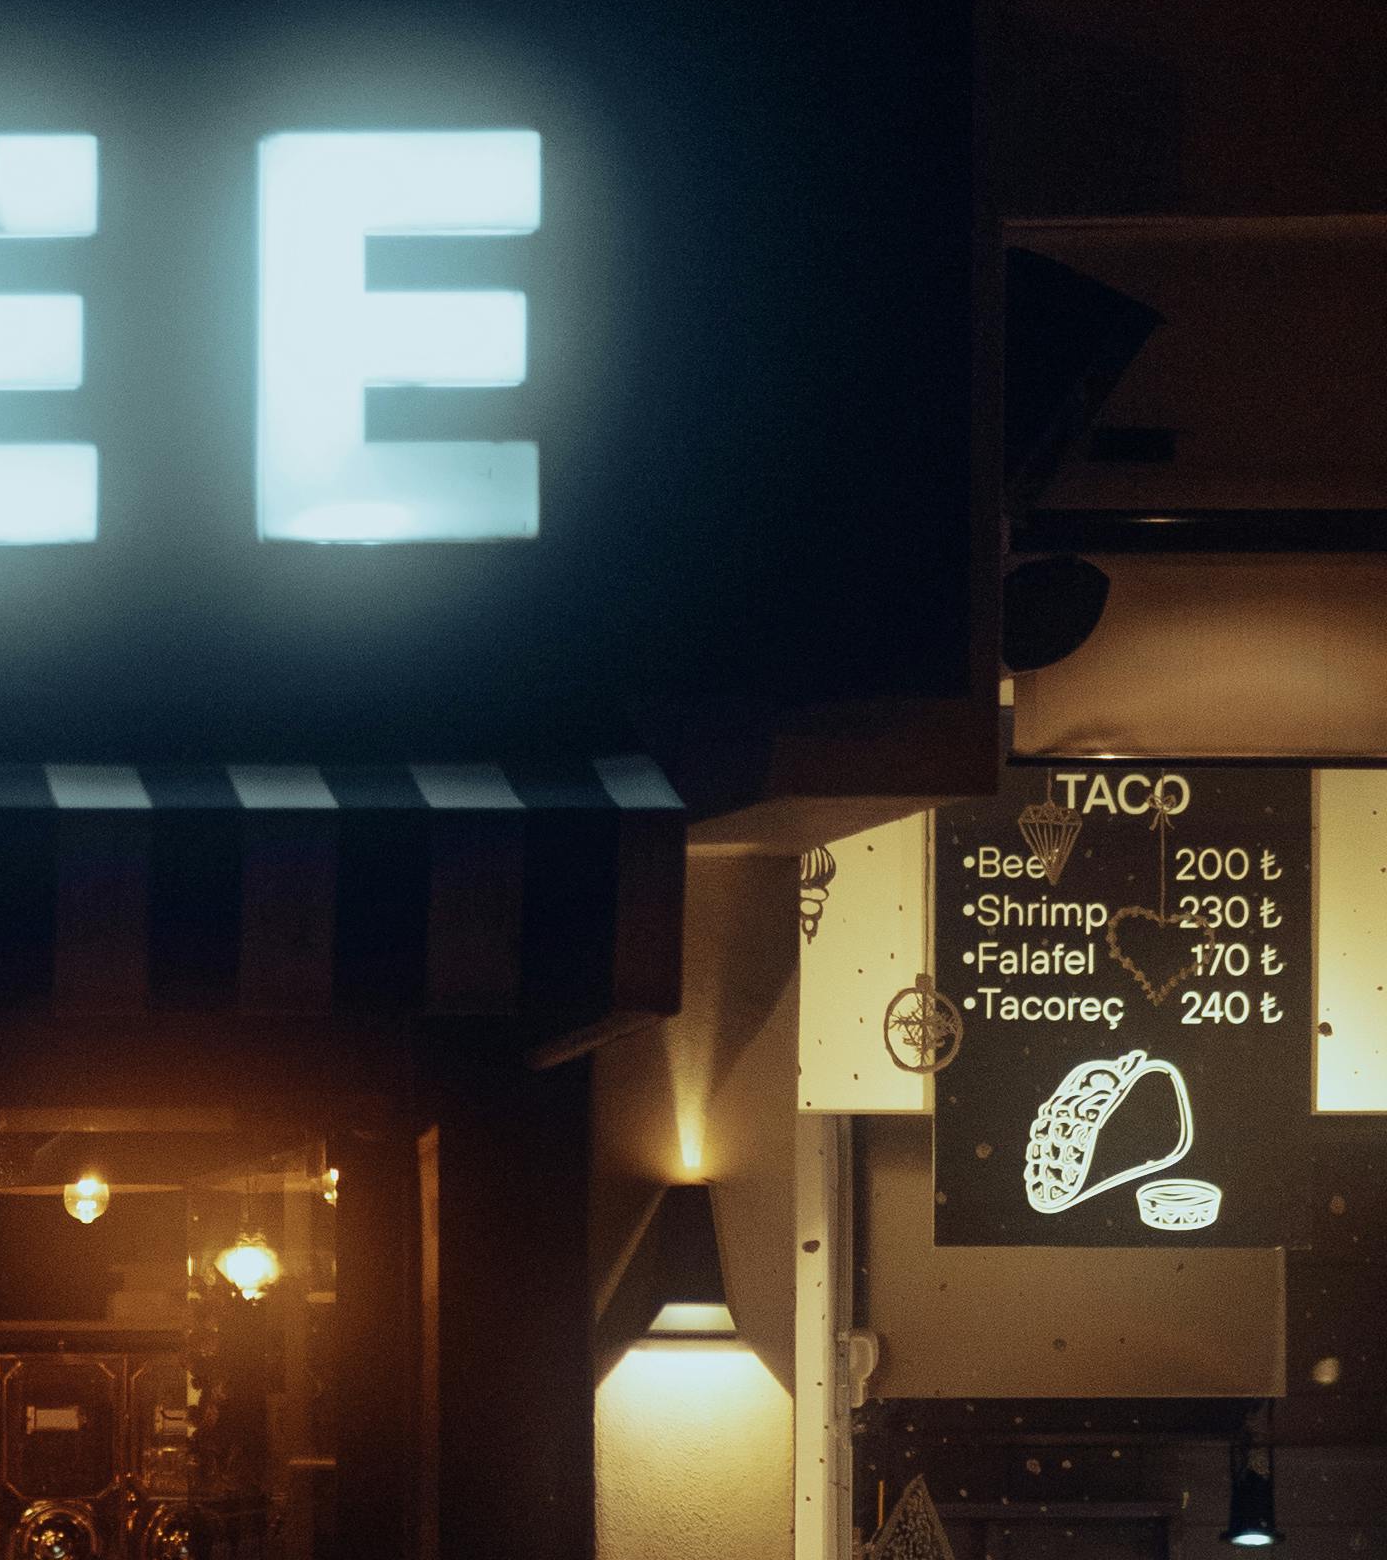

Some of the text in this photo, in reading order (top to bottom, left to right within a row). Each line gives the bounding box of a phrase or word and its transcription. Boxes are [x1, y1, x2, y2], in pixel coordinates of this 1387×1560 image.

[1056, 774, 1190, 815] TACO
[978, 846, 1049, 879] Bee
[1175, 847, 1249, 881] 200
[977, 893, 1108, 936] Shrimp
[1179, 895, 1249, 929] 230
[978, 941, 1095, 976] Falafel
[1190, 943, 1250, 977] 170
[977, 987, 1125, 1031] Tacoreç
[1180, 991, 1250, 1025] 240
